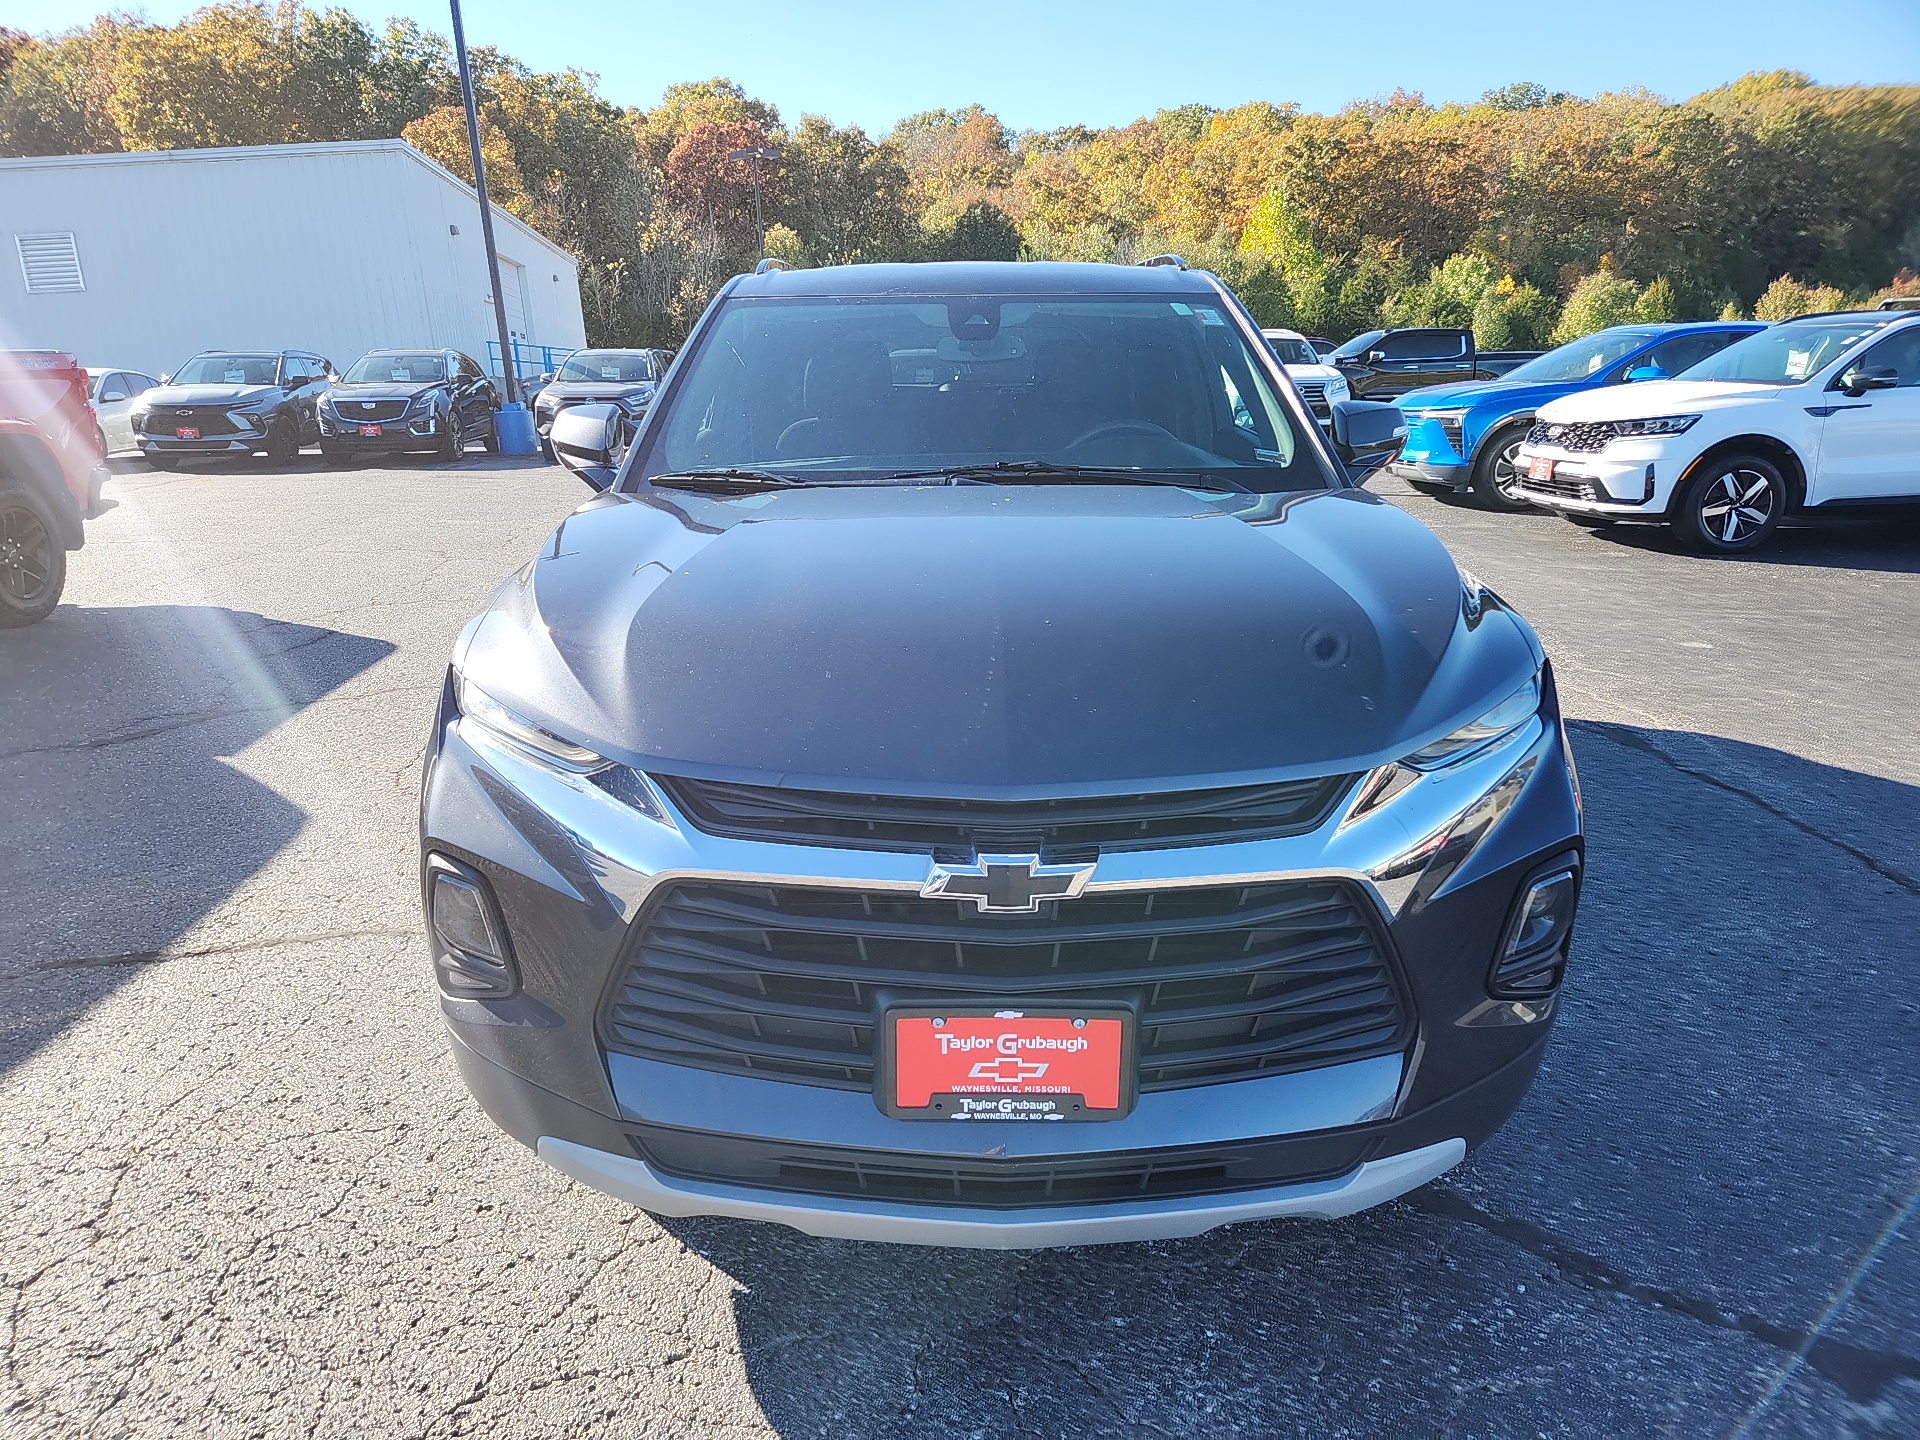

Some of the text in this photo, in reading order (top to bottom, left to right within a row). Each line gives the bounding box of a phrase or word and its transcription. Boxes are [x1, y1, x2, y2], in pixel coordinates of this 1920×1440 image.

[935, 1033, 1088, 1055] Taylor Grubaugh
[951, 1085, 1071, 1094] WAYNESVILLE, MISSOURI
[959, 1098, 1056, 1113] Taylor Grubaugh
[973, 1112, 1043, 1120] WAYNESVILLE, MO
